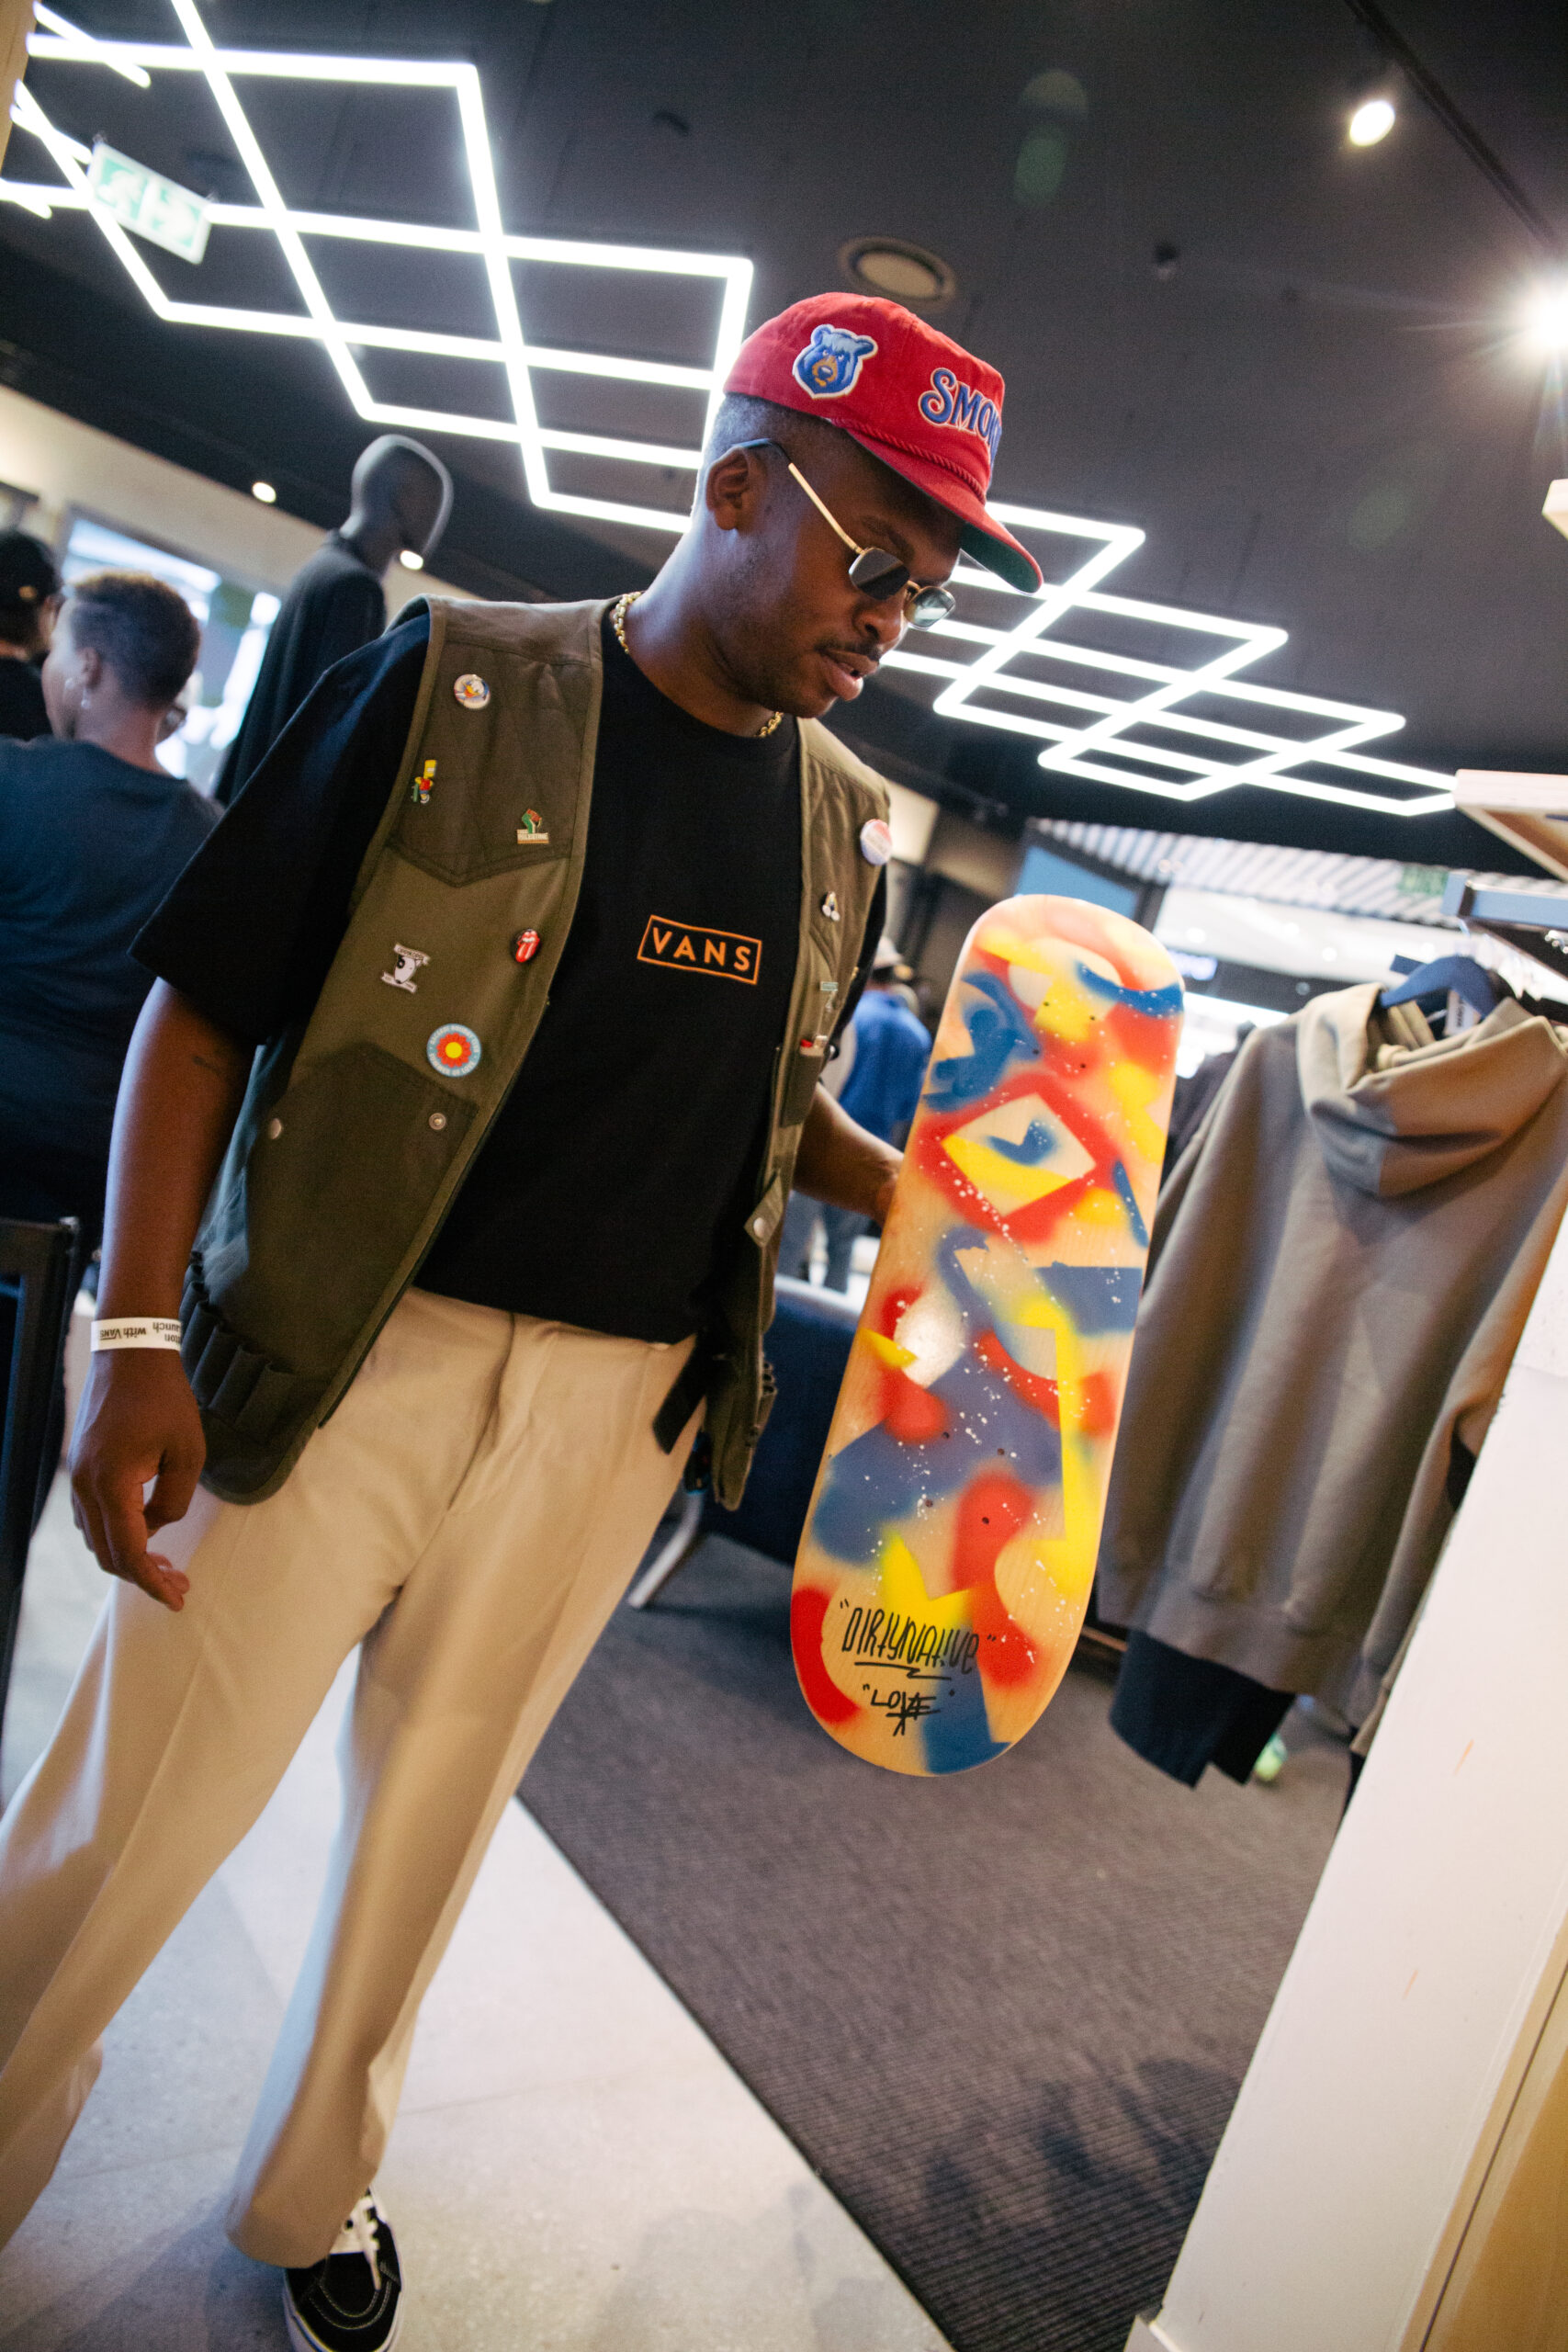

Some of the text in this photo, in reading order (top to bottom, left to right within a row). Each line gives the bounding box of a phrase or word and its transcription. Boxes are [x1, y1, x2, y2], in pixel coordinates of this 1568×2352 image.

[653, 927, 751, 972] VANS
[122, 1327, 147, 1339] with
[152, 1322, 181, 1333] aunch
